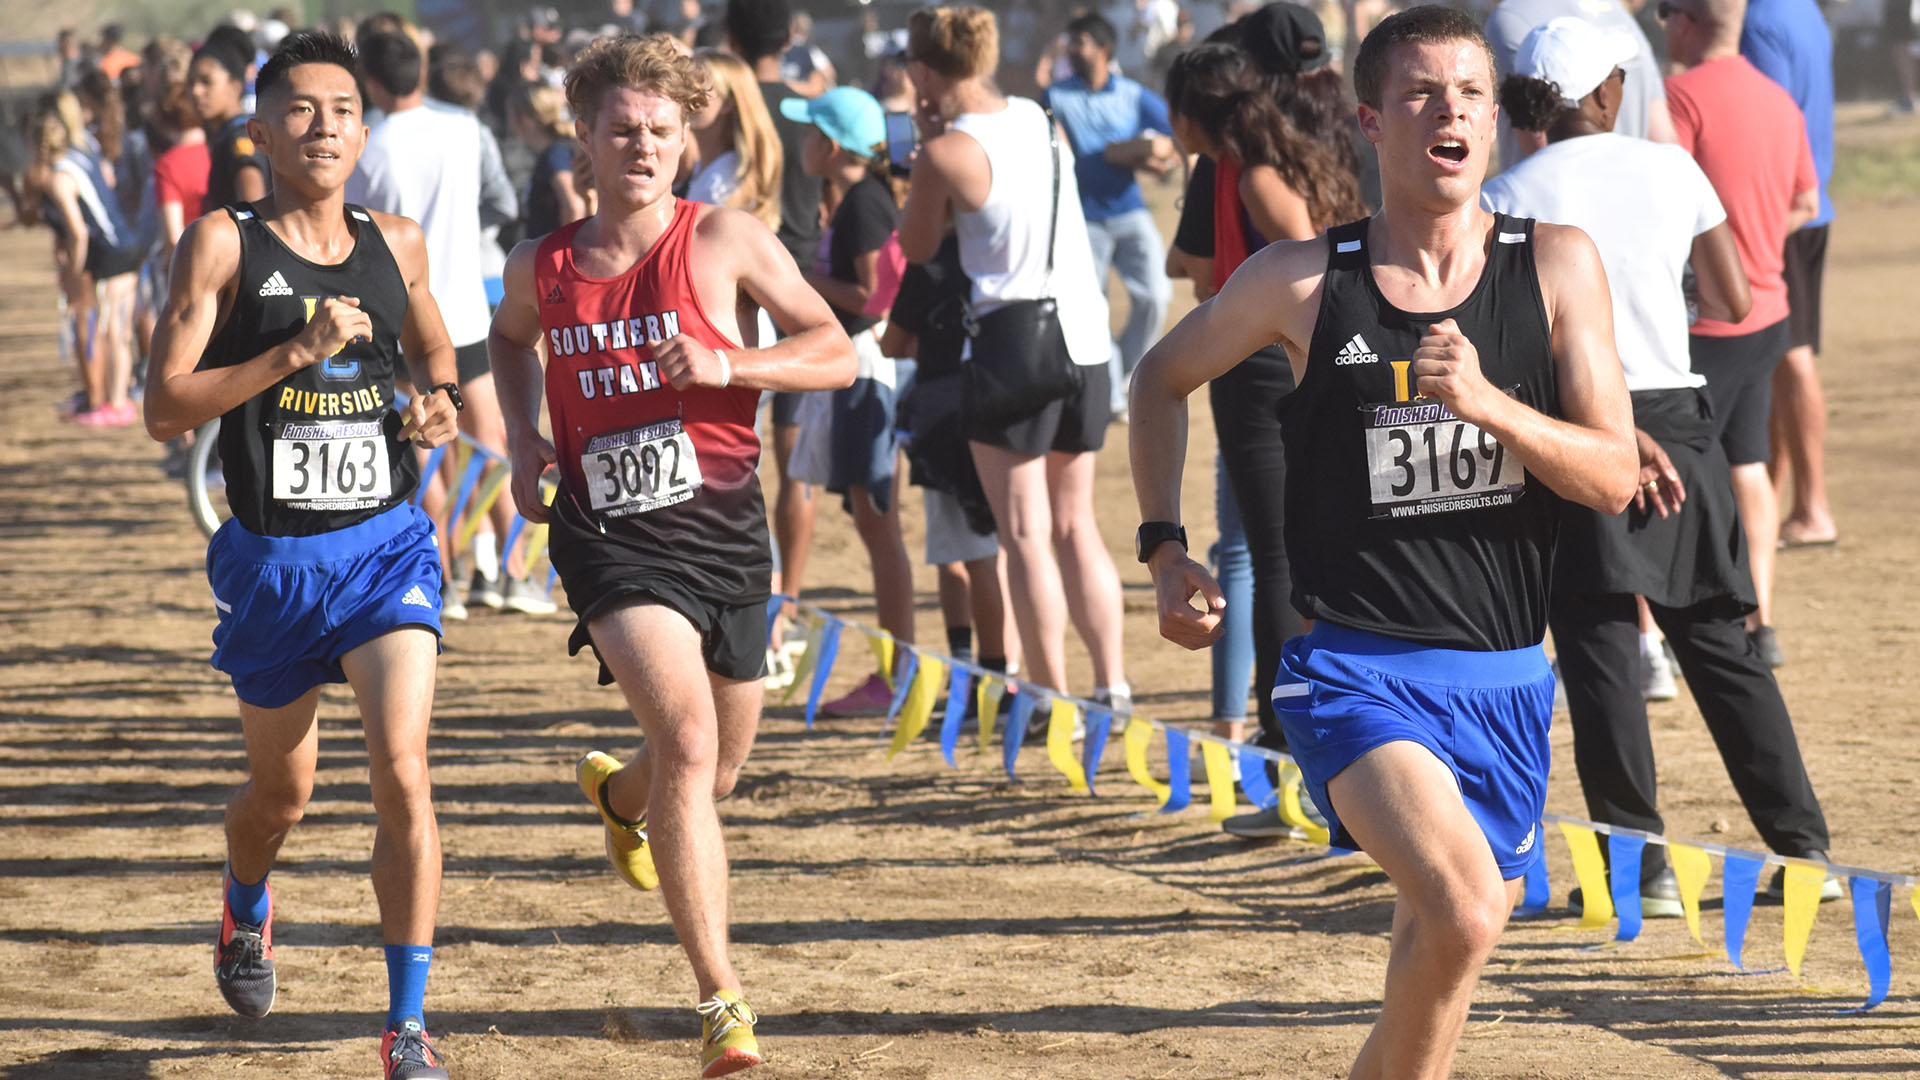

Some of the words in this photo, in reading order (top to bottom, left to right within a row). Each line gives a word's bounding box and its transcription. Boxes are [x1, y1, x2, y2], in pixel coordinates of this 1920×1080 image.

[259, 286, 293, 297] adidas
[550, 311, 680, 356] SOUTHERN
[1335, 352, 1379, 366] adidas
[578, 361, 662, 399] UTAH
[279, 384, 384, 416] RIVERSIDE
[1375, 405, 1438, 425] FINISHED
[632, 420, 681, 443] RESULTS
[289, 439, 378, 495] 3163
[597, 438, 688, 503] 3092
[1388, 423, 1505, 497] 3169
[1391, 494, 1512, 517] WWW.FINISHEDRESULTS.COM
